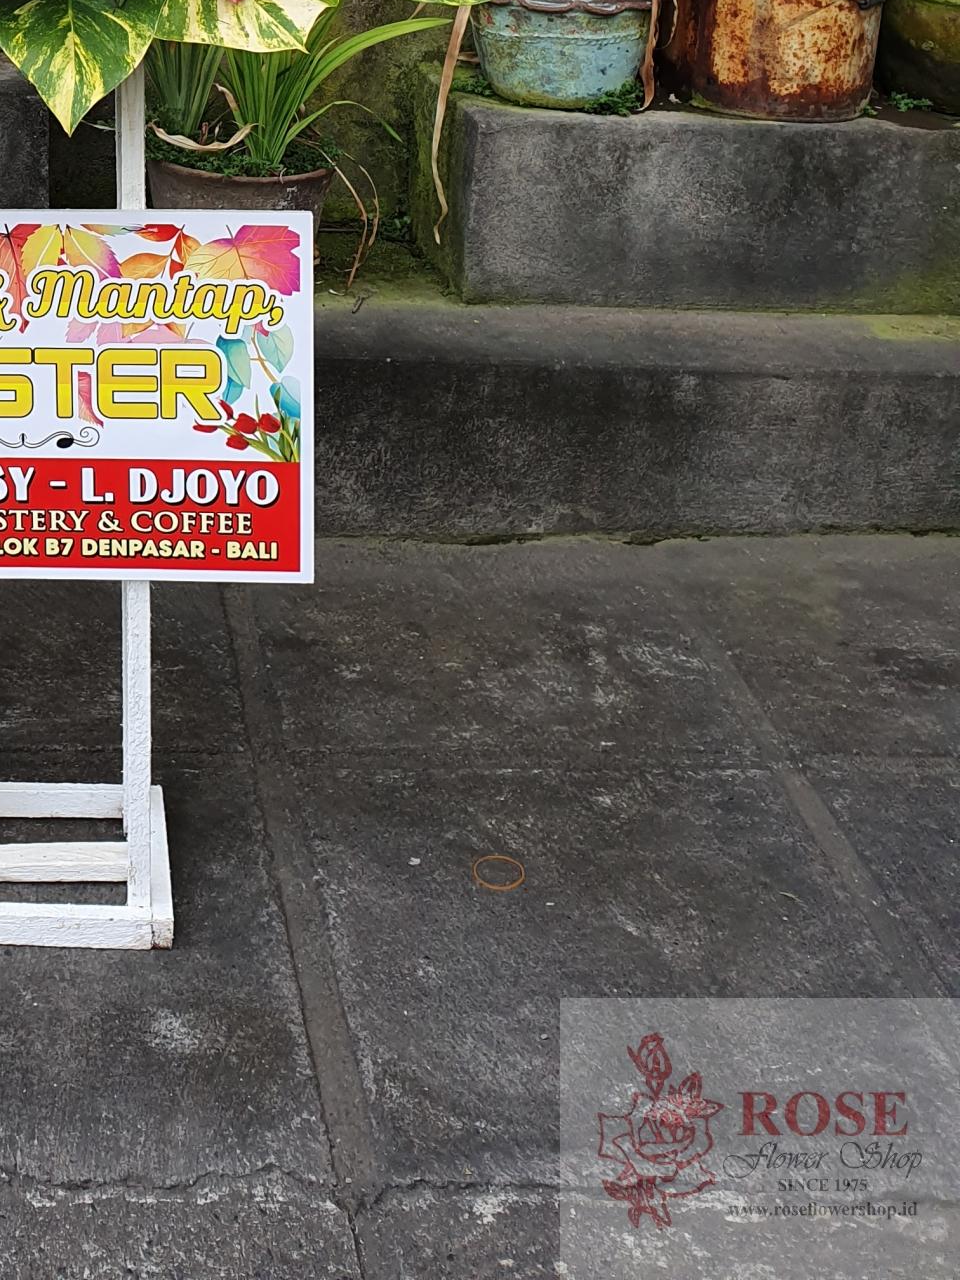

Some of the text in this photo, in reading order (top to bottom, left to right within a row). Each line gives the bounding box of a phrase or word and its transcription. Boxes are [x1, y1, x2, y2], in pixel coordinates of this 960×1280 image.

[26, 269, 285, 334] Mantap,
[81, 468, 114, 503] L.
[129, 468, 279, 505] DJOYO
[97, 511, 123, 533] &
[131, 511, 252, 535] COFFEE
[45, 538, 74, 557] B7
[81, 539, 205, 558] DENPASAR
[226, 541, 278, 560] BALI
